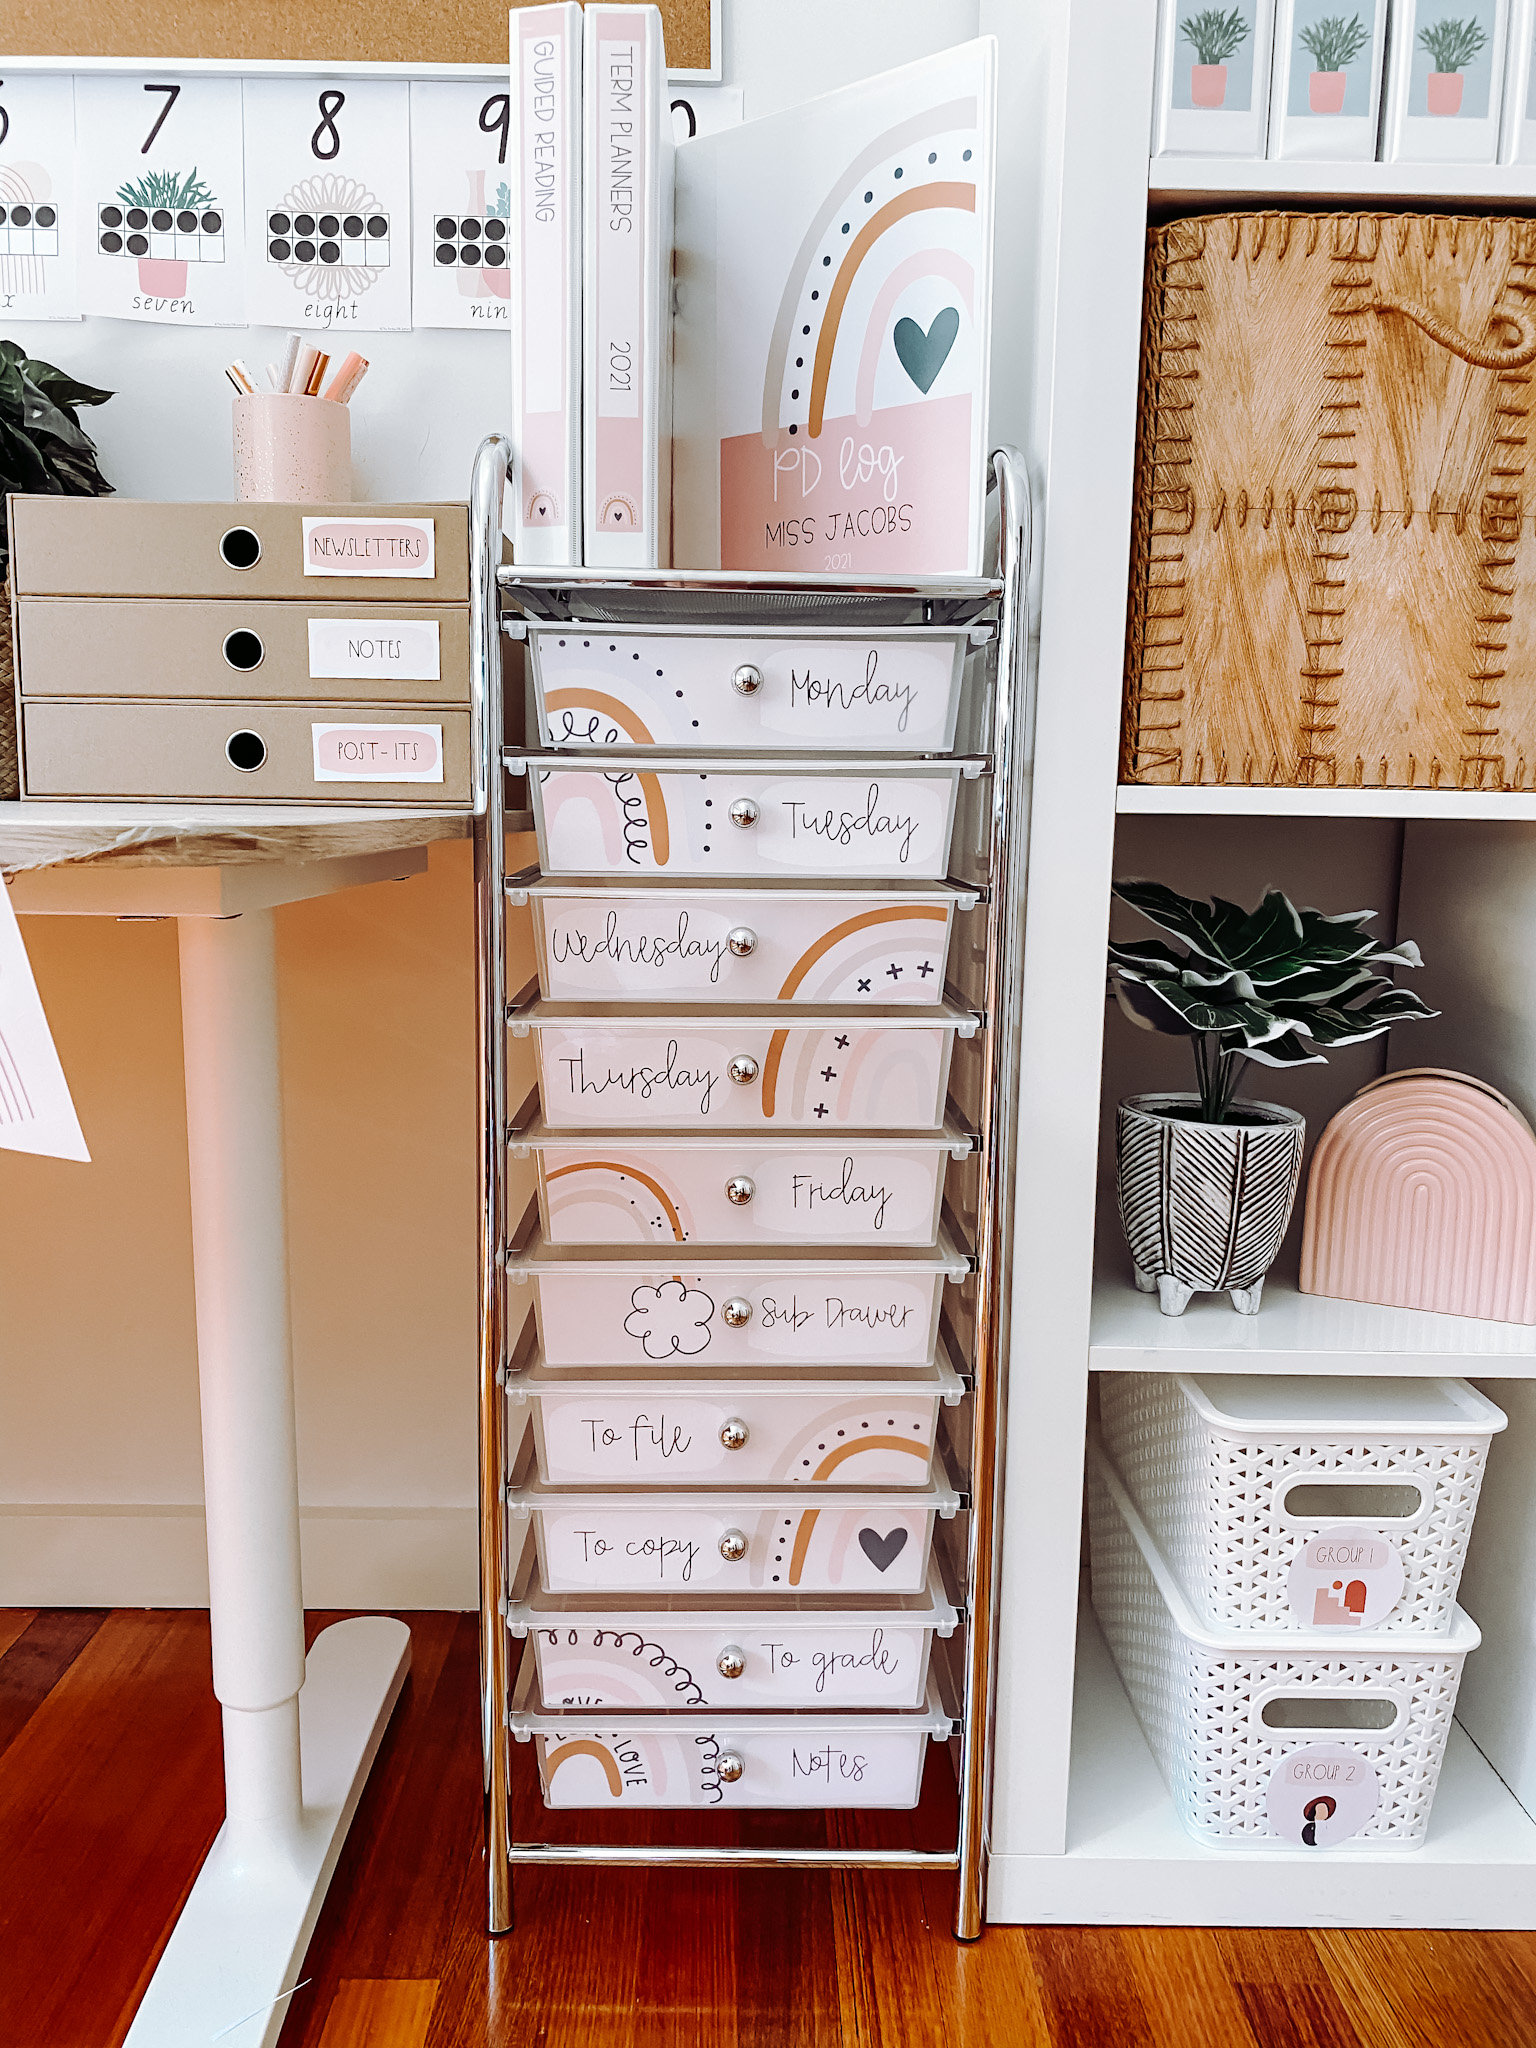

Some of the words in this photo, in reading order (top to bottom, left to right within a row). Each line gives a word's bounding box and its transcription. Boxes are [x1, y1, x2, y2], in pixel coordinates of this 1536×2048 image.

[534, 41, 554, 121] GUIDED
[611, 46, 632, 111] TERM
[141, 84, 181, 155] 7
[311, 90, 345, 160] 8
[479, 94, 509, 164] 9
[535, 132, 555, 221] READING
[610, 123, 632, 232] PLANNERS
[133, 297, 194, 313] seven
[304, 296, 359, 330] eight
[470, 302, 508, 319] nin
[610, 342, 631, 390] 2021
[774, 447, 822, 501] PD
[840, 438, 904, 501] log
[314, 537, 421, 557] NEWSLETTERS
[766, 518, 815, 548] MISS
[826, 504, 913, 540] JACOBS
[824, 553, 853, 571] 2021
[349, 640, 401, 658] NOTES
[791, 650, 918, 732] Monday
[782, 783, 918, 862] Tuesday
[552, 910, 727, 983] Wednesday
[559, 1040, 718, 1114] Thursday
[793, 1157, 892, 1229] Friday
[762, 1295, 814, 1332] Sub
[826, 1298, 913, 1328] Drawer
[581, 1419, 623, 1452] To
[629, 1415, 691, 1461] file
[574, 1532, 613, 1561] To
[626, 1537, 699, 1581] copy
[1317, 1547, 1363, 1563] GROUP
[761, 1644, 800, 1673] To
[813, 1628, 898, 1692] grade
[613, 1739, 648, 1787] LOVE
[793, 1745, 867, 1782] Notes
[1293, 1763, 1341, 1781] GROUP
[1345, 1765, 1357, 1782] 2
